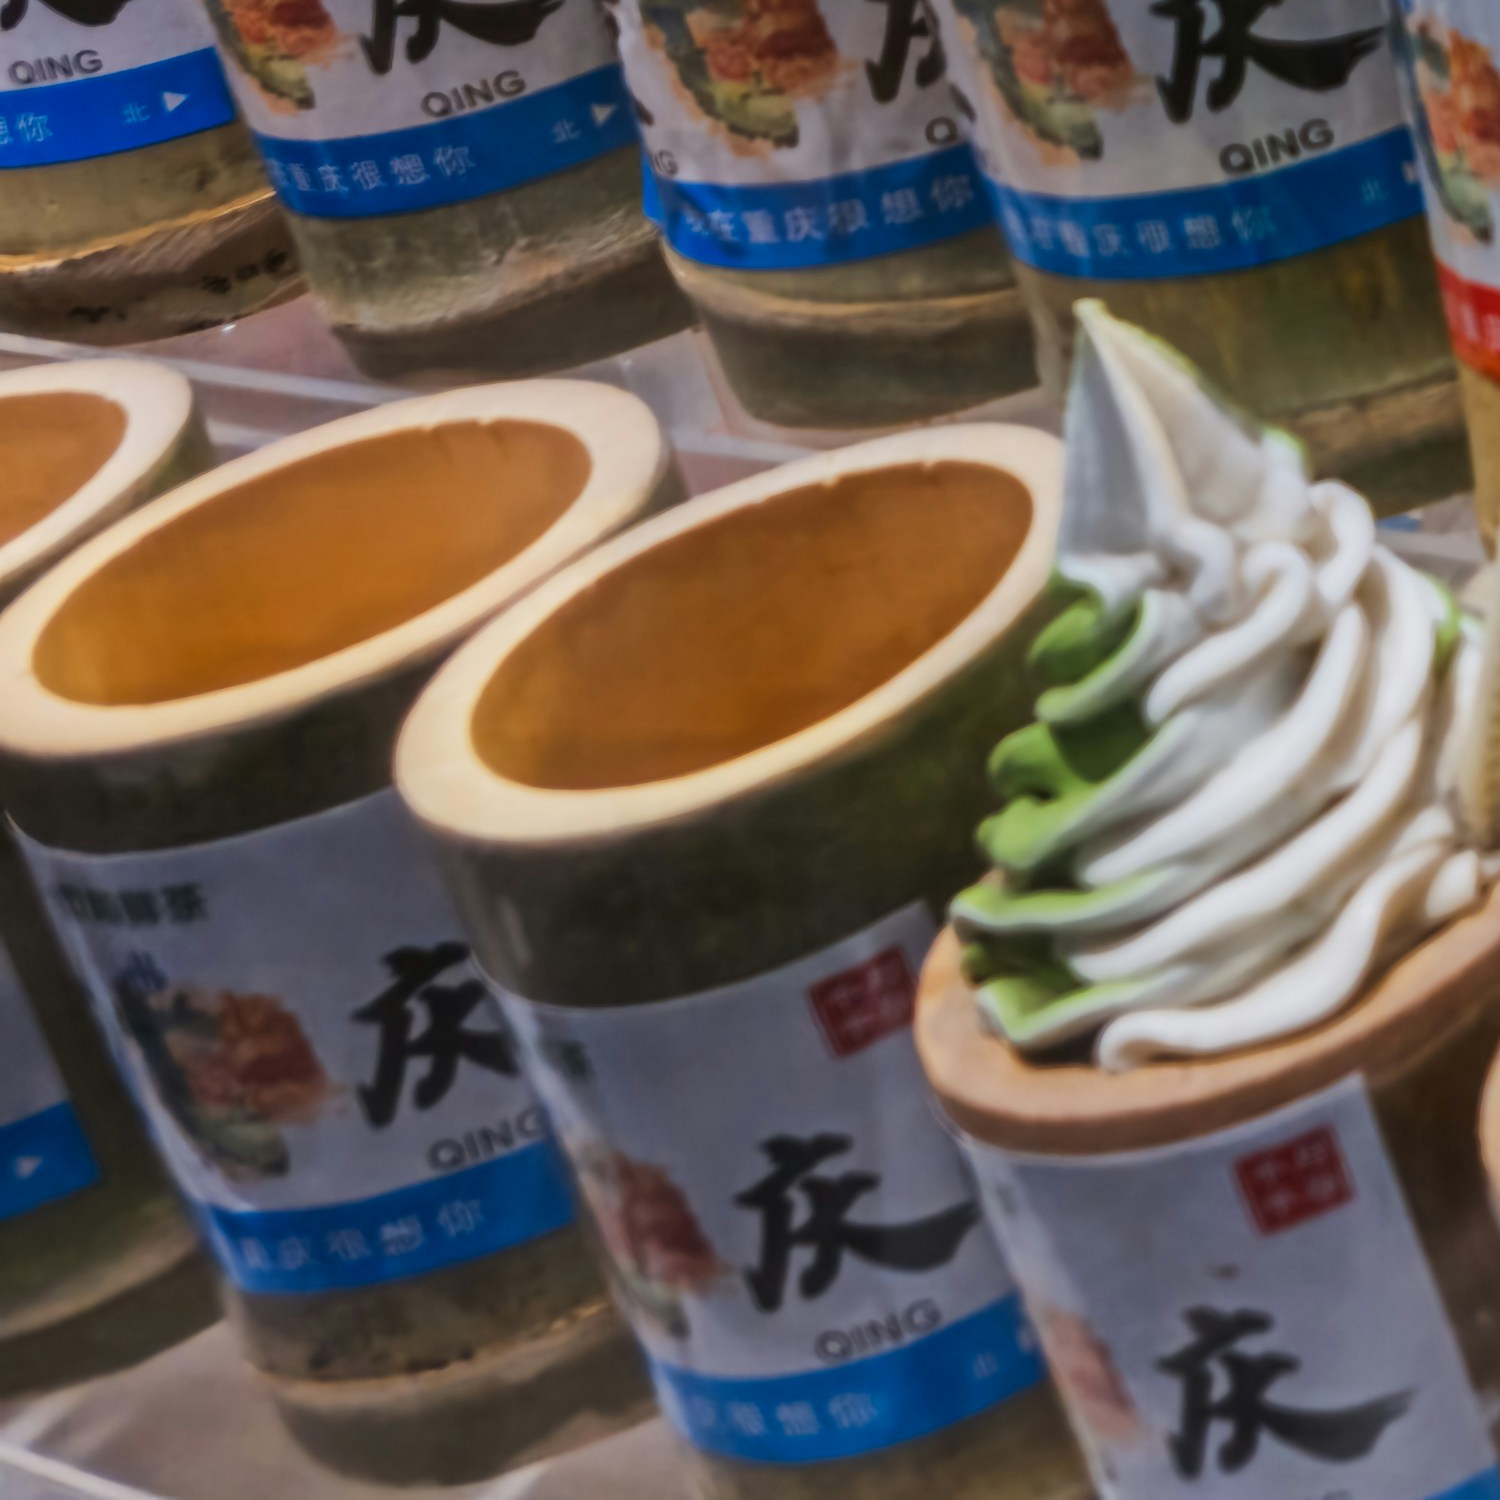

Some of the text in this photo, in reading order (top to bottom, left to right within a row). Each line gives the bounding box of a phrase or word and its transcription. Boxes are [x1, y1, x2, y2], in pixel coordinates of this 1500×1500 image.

[9, 48, 103, 87] QING
[420, 69, 527, 119] QING
[1219, 116, 1335, 176] QING
[350, 941, 520, 1130] 庆
[733, 1131, 984, 1315] 庆
[813, 1298, 944, 1366] QING
[1154, 1305, 1418, 1481] 庆
